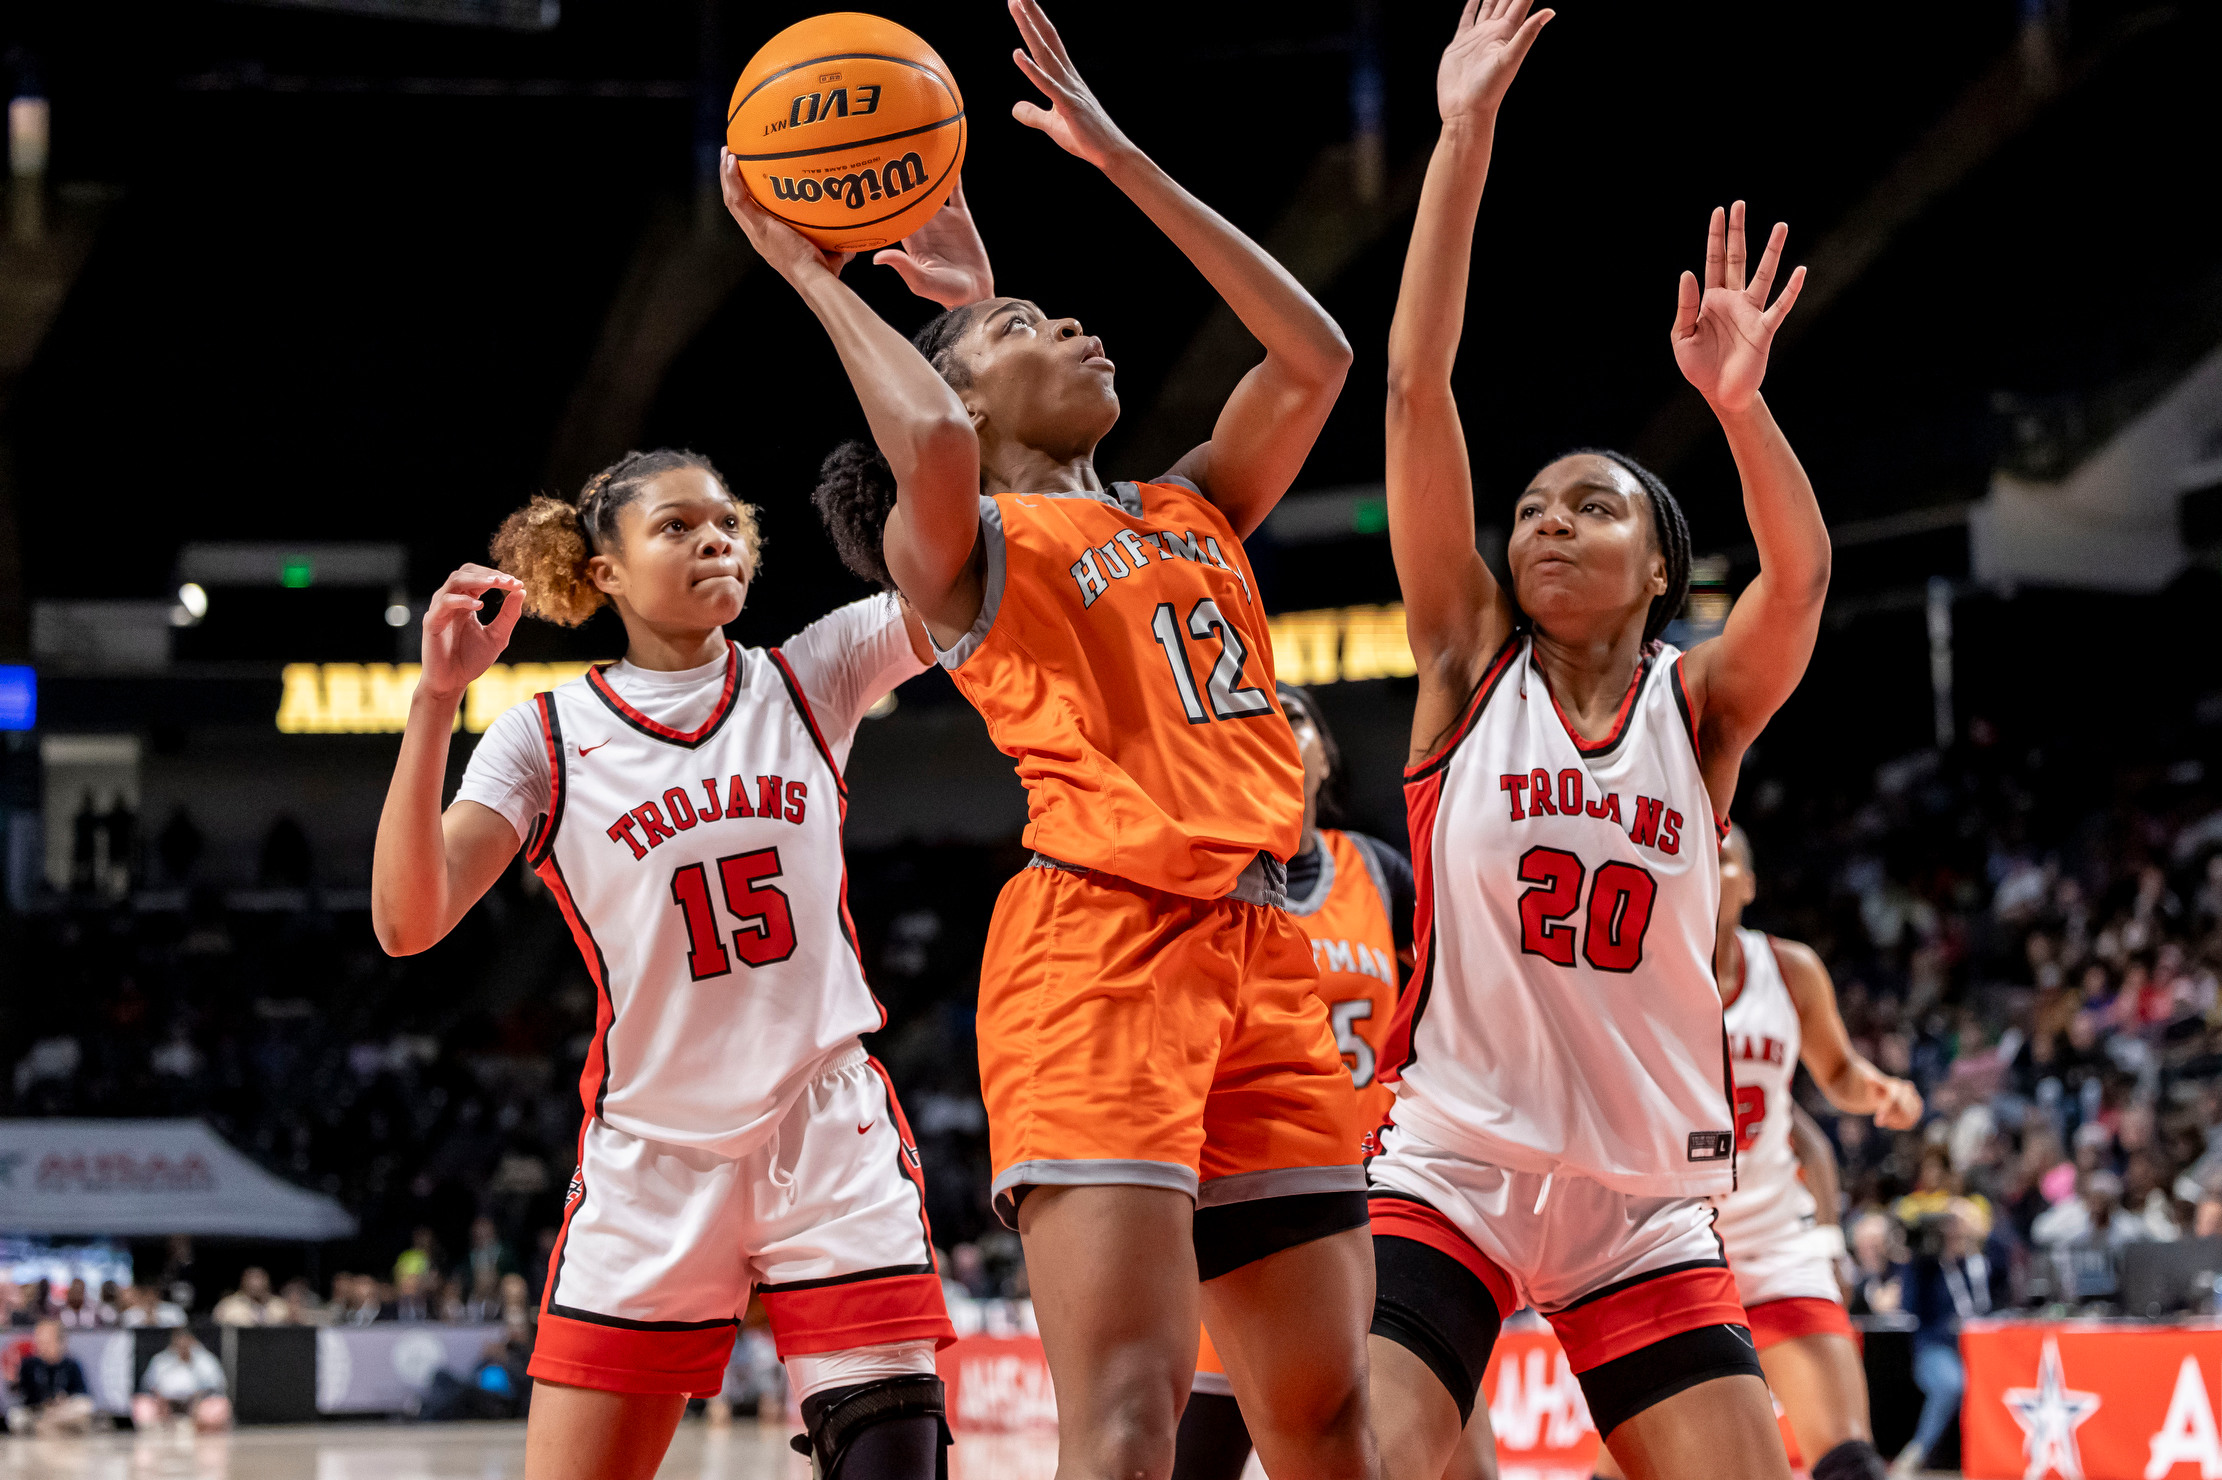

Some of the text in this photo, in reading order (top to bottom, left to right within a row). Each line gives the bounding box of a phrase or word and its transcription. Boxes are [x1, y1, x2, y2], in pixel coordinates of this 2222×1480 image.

[763, 85, 881, 137] EVO NXT
[769, 151, 929, 210] Wilson
[850, 156, 881, 169] INDOOR
[1151, 597, 1275, 725] 12
[606, 774, 807, 861] TROJANS
[670, 846, 798, 982] 15
[1517, 845, 1658, 973] 20
[1719, 1139, 1726, 1152] L
